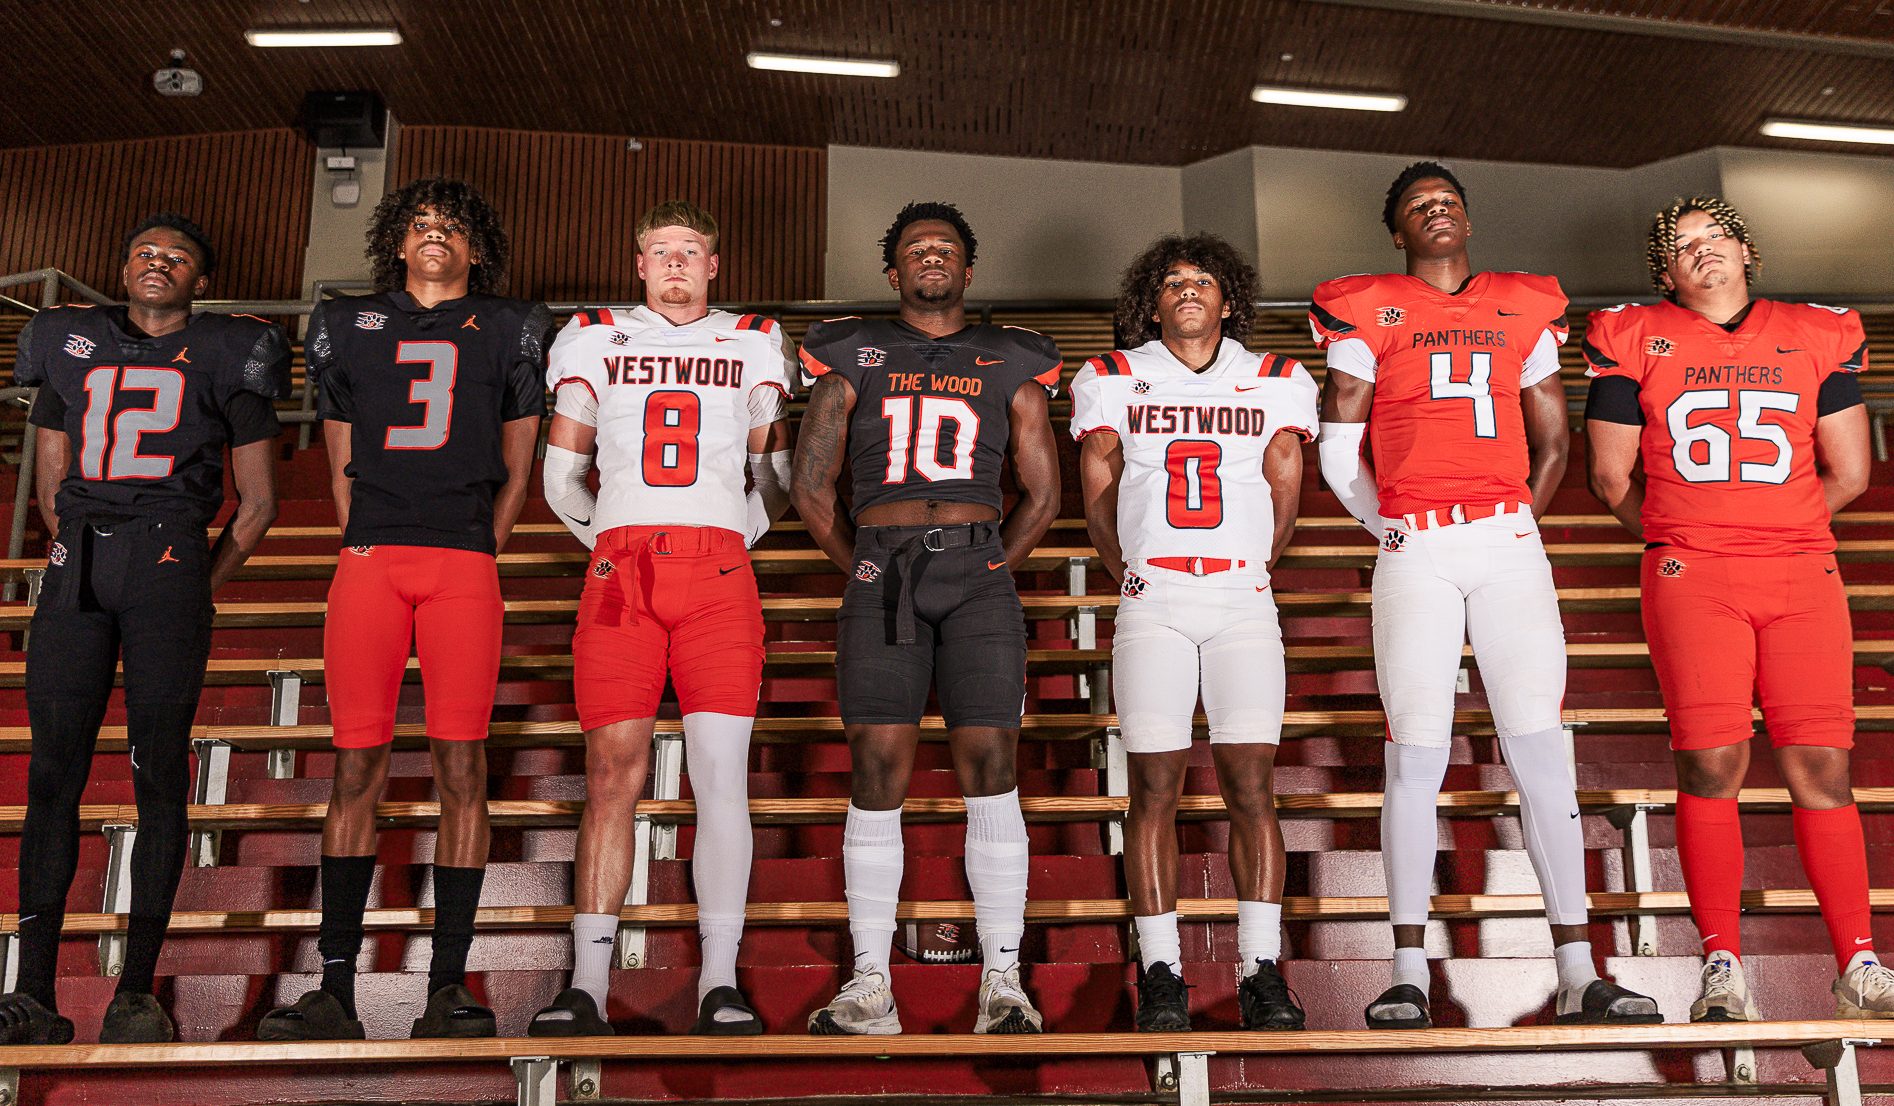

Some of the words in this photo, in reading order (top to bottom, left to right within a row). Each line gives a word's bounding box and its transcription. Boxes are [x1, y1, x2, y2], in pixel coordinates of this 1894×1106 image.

[603, 356, 744, 389] WESTWOOD
[1412, 329, 1506, 349] PANTHERS
[1684, 365, 1783, 385] PANTHERS
[80, 366, 185, 480] 12
[385, 340, 459, 450] 3
[888, 372, 924, 391] THE
[931, 374, 983, 396] WOOD
[1126, 405, 1265, 437] WESTWOOD
[1429, 352, 1497, 438] 4
[642, 390, 701, 487] 8
[882, 395, 981, 485] 10
[1666, 389, 1800, 485] 65
[1165, 439, 1223, 529] 0
